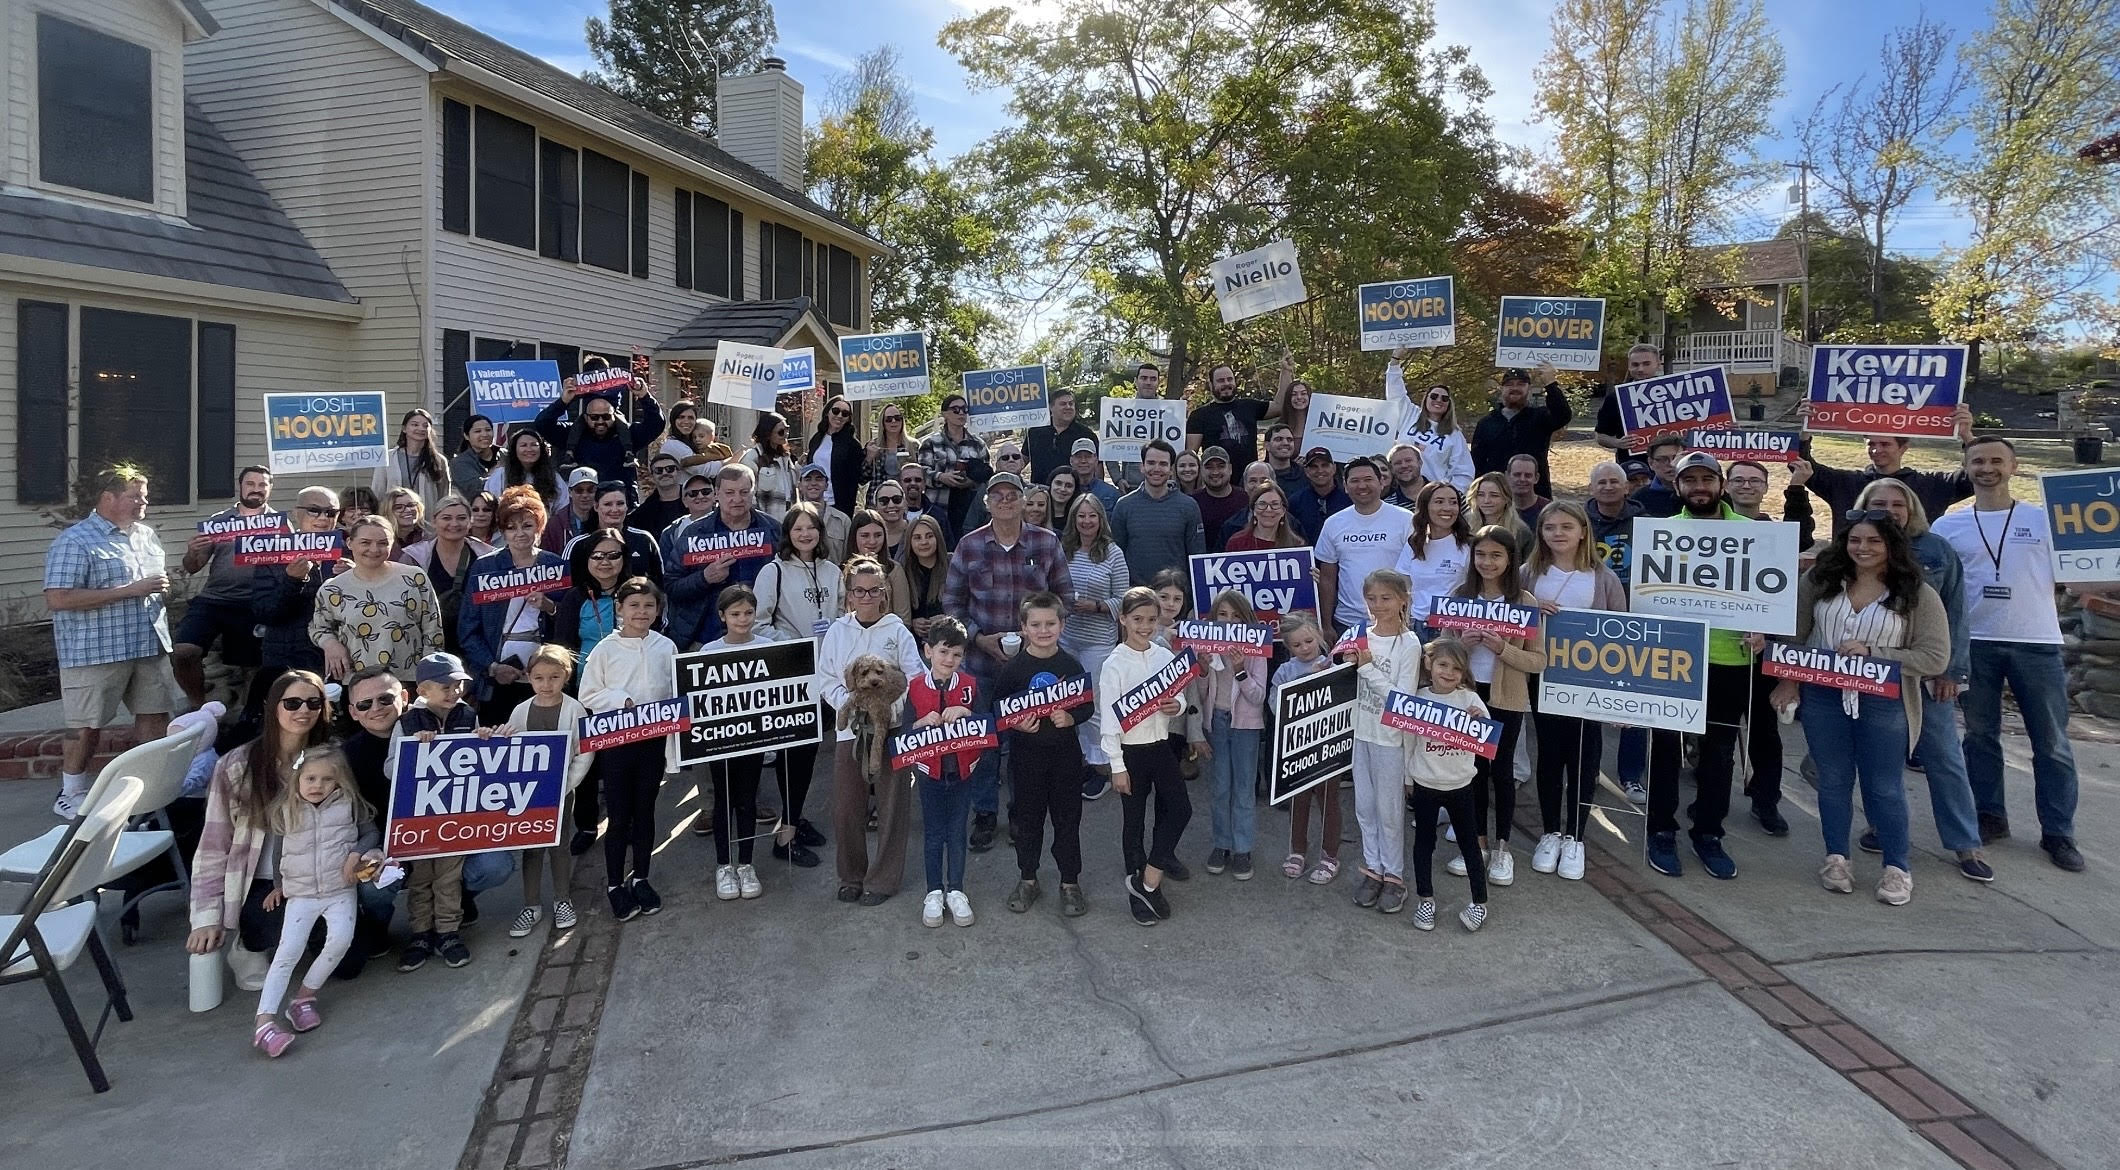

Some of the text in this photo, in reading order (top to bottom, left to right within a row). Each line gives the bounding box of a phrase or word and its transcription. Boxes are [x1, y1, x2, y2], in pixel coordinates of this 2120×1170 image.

[1236, 260, 1257, 269] Roger
[1225, 261, 1292, 292] Niello
[1384, 283, 1427, 300] JOSH
[1364, 297, 1446, 322] HOOVER
[1528, 302, 1576, 316] JOSH
[1364, 328, 1450, 344] For Assembly
[1503, 317, 1594, 339] HOOVER
[863, 337, 902, 351] JOSH
[782, 360, 809, 373] NYA
[845, 350, 920, 373] HOOVER
[1500, 349, 1596, 365] For Assembly
[1827, 349, 1947, 377] Kevin
[478, 369, 516, 378] Valentine
[576, 370, 607, 385] Kevin
[607, 367, 632, 381] Kiley
[722, 358, 775, 381] Niello
[781, 370, 809, 379] VCHUK
[986, 370, 1024, 385] JOSH
[473, 378, 560, 401] Martinez
[847, 384, 865, 394] For
[870, 378, 926, 391] Assembly
[969, 383, 1041, 406] HOOVER
[1628, 374, 1715, 407] Kevin
[1827, 376, 1936, 411] Kiley
[299, 397, 355, 413] JOSH
[1112, 405, 1165, 421] Roger
[1336, 404, 1360, 413] Roger
[1634, 399, 1710, 428] Kiley
[273, 413, 377, 439] HOOVER
[970, 416, 987, 426] For
[992, 410, 1046, 424] Assembly
[1318, 412, 1389, 436] Niello
[1846, 408, 1952, 429] Congress
[1106, 420, 1181, 441] Niello
[1407, 422, 1446, 450] USA
[1637, 434, 1651, 444] or
[1693, 431, 1791, 454] Kevin Kiley
[274, 447, 384, 465] For Assembly
[1708, 452, 1730, 460] hting
[1747, 452, 1788, 461] California
[203, 515, 281, 535] Kevin Kiley
[241, 535, 291, 553] Kevin
[294, 532, 335, 552] Kiley
[687, 530, 764, 553] Kevin Kiley
[1343, 533, 1387, 543] HOOVER
[1653, 529, 1755, 558] Roger
[244, 555, 279, 564] Fighting
[692, 554, 720, 563] Fighting
[733, 548, 764, 557] California
[2058, 553, 2104, 570] For
[478, 564, 564, 592] Kevin Kiley
[1204, 554, 1301, 585] Kevin
[1641, 554, 1788, 594] Niello
[483, 590, 514, 601] Fighting
[530, 582, 563, 592] California
[1437, 598, 1532, 628] Kevin Kiley
[1653, 596, 1769, 613] FOR STATE SENATE
[1179, 620, 1223, 641] Kevin
[1225, 623, 1266, 647] Kiley
[1438, 618, 1470, 629] Fighting
[1487, 623, 1526, 636] California
[1586, 617, 1661, 643] JOSH
[1548, 637, 1693, 683] HOOVER
[1771, 643, 1890, 684] Kevin Kiley
[686, 659, 770, 687] TANYA
[1774, 666, 1884, 693] Fighting For California
[960, 686, 972, 705] J
[1117, 654, 1191, 717] Kevin Kiley
[693, 682, 809, 719] KRAVCHUK
[1000, 678, 1084, 717] Kevin Kiley
[1129, 672, 1193, 725] Fighting California
[1287, 685, 1332, 719] TANYA
[1544, 685, 1579, 704] For
[1586, 691, 1699, 725] Assembly
[585, 702, 682, 738] Kevin Kiley
[691, 722, 756, 743] SCHOOL
[762, 711, 815, 732] BOARD
[1006, 711, 1036, 725] Fight
[1037, 707, 1050, 716] For
[1392, 694, 1494, 743] Kevin Kiley
[590, 723, 681, 749] Fighting For California
[895, 718, 987, 754] Kevin Kiley
[1286, 707, 1352, 752] KRAVCHUK
[1391, 717, 1485, 753] Fighting For California
[415, 737, 550, 778] Kevin
[902, 739, 987, 764] Fighting For California
[1282, 755, 1318, 779] SCHOOL
[1321, 738, 1353, 761] BOARD
[414, 776, 538, 816] Kiley
[392, 819, 555, 846] for Congress
